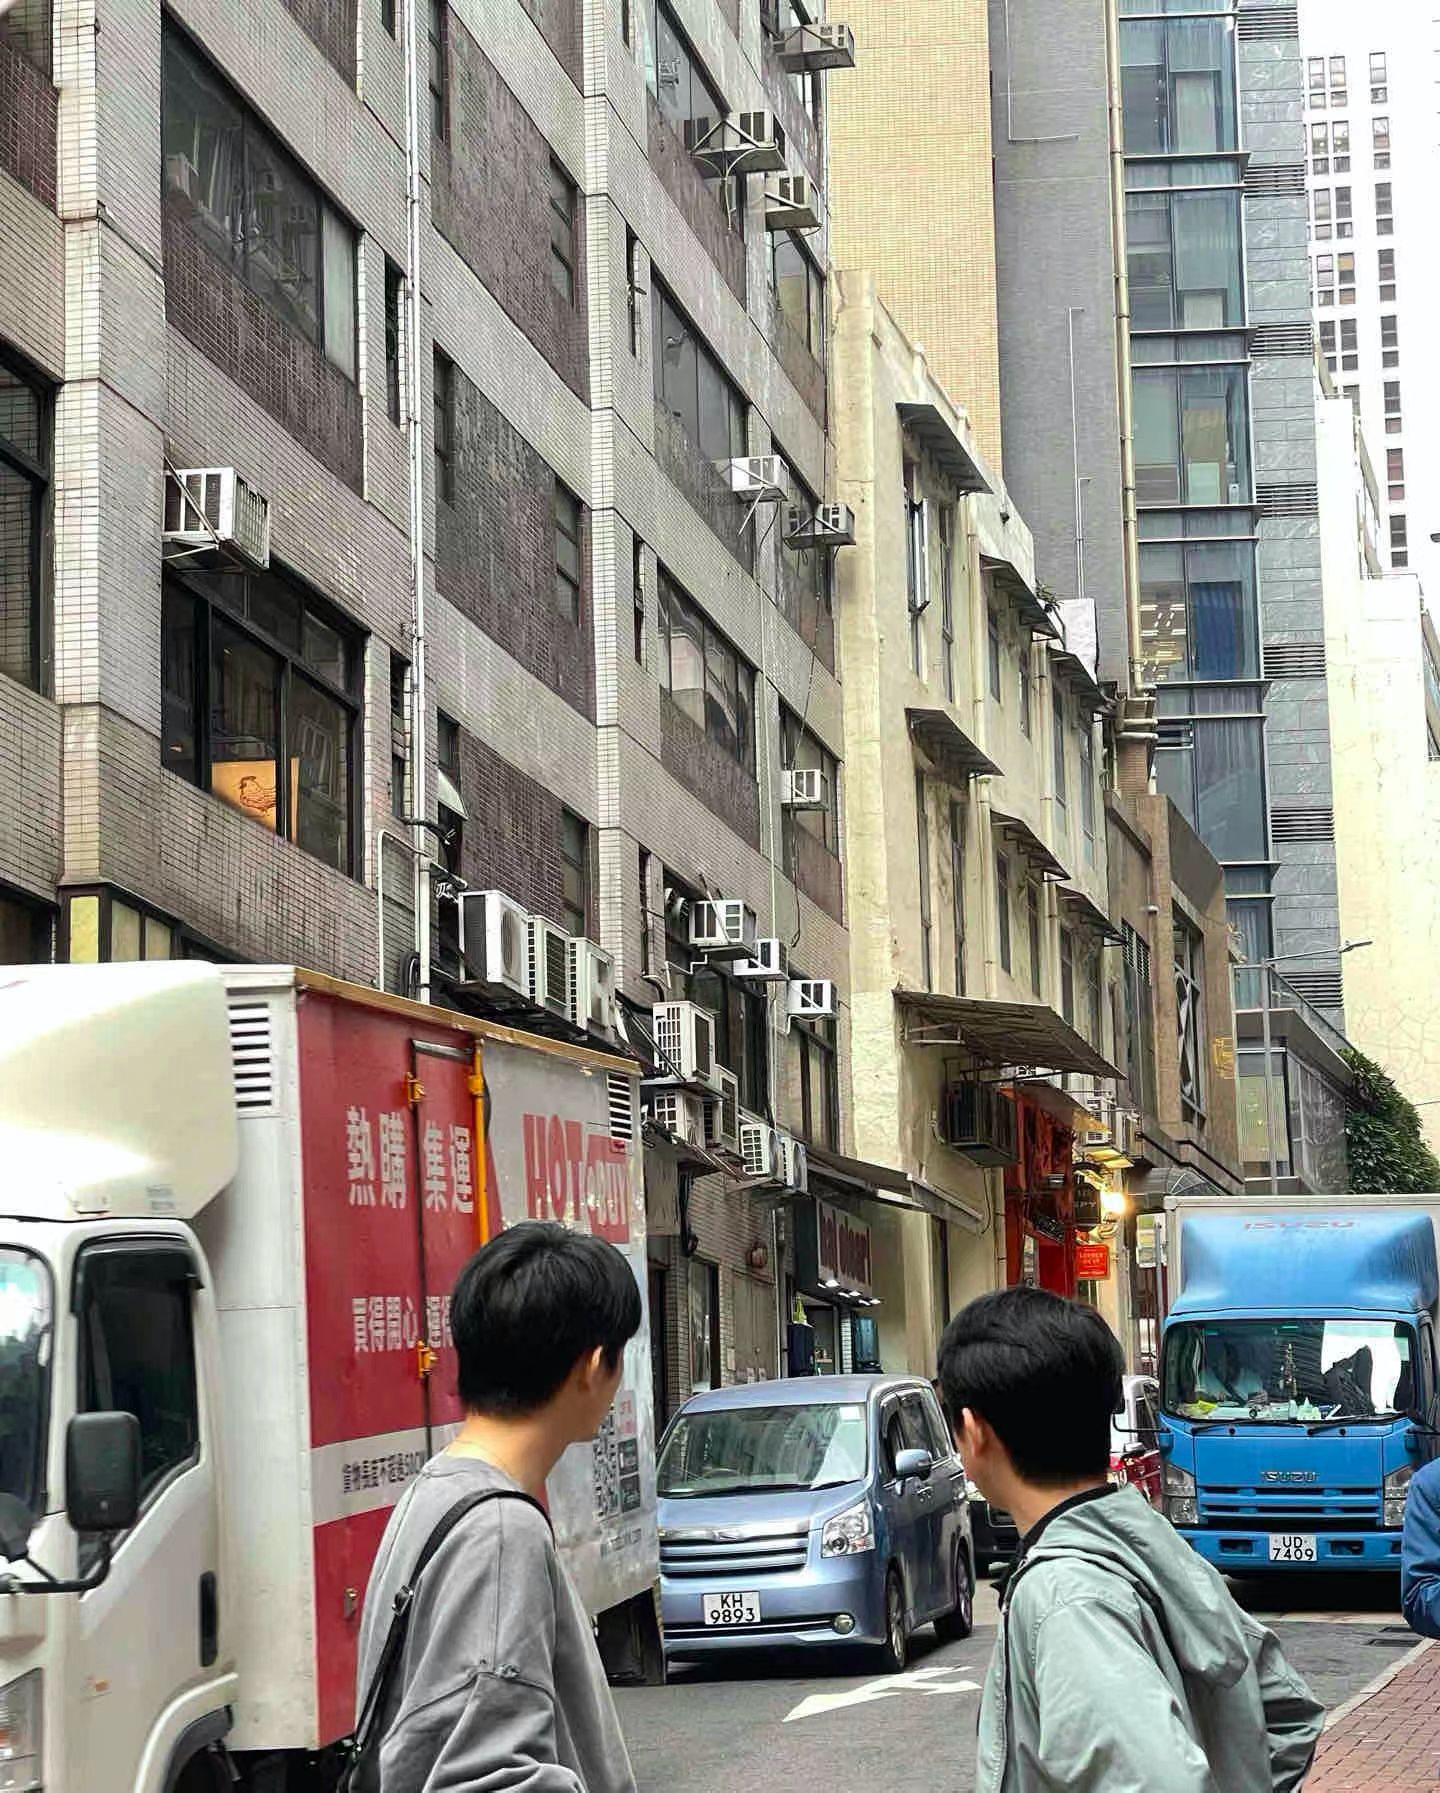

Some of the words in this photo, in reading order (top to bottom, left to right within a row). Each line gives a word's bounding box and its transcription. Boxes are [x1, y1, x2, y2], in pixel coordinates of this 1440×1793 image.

[346, 1105, 474, 1213] 熱購集運
[523, 1113, 583, 1222] HOT
[351, 1296, 419, 1352] 買得開心
[1261, 1471, 1319, 1484] ISUZU
[1282, 1535, 1303, 1548] UD
[1272, 1547, 1314, 1560] 7409
[720, 1593, 743, 1608] KH
[710, 1607, 755, 1624] 9893
